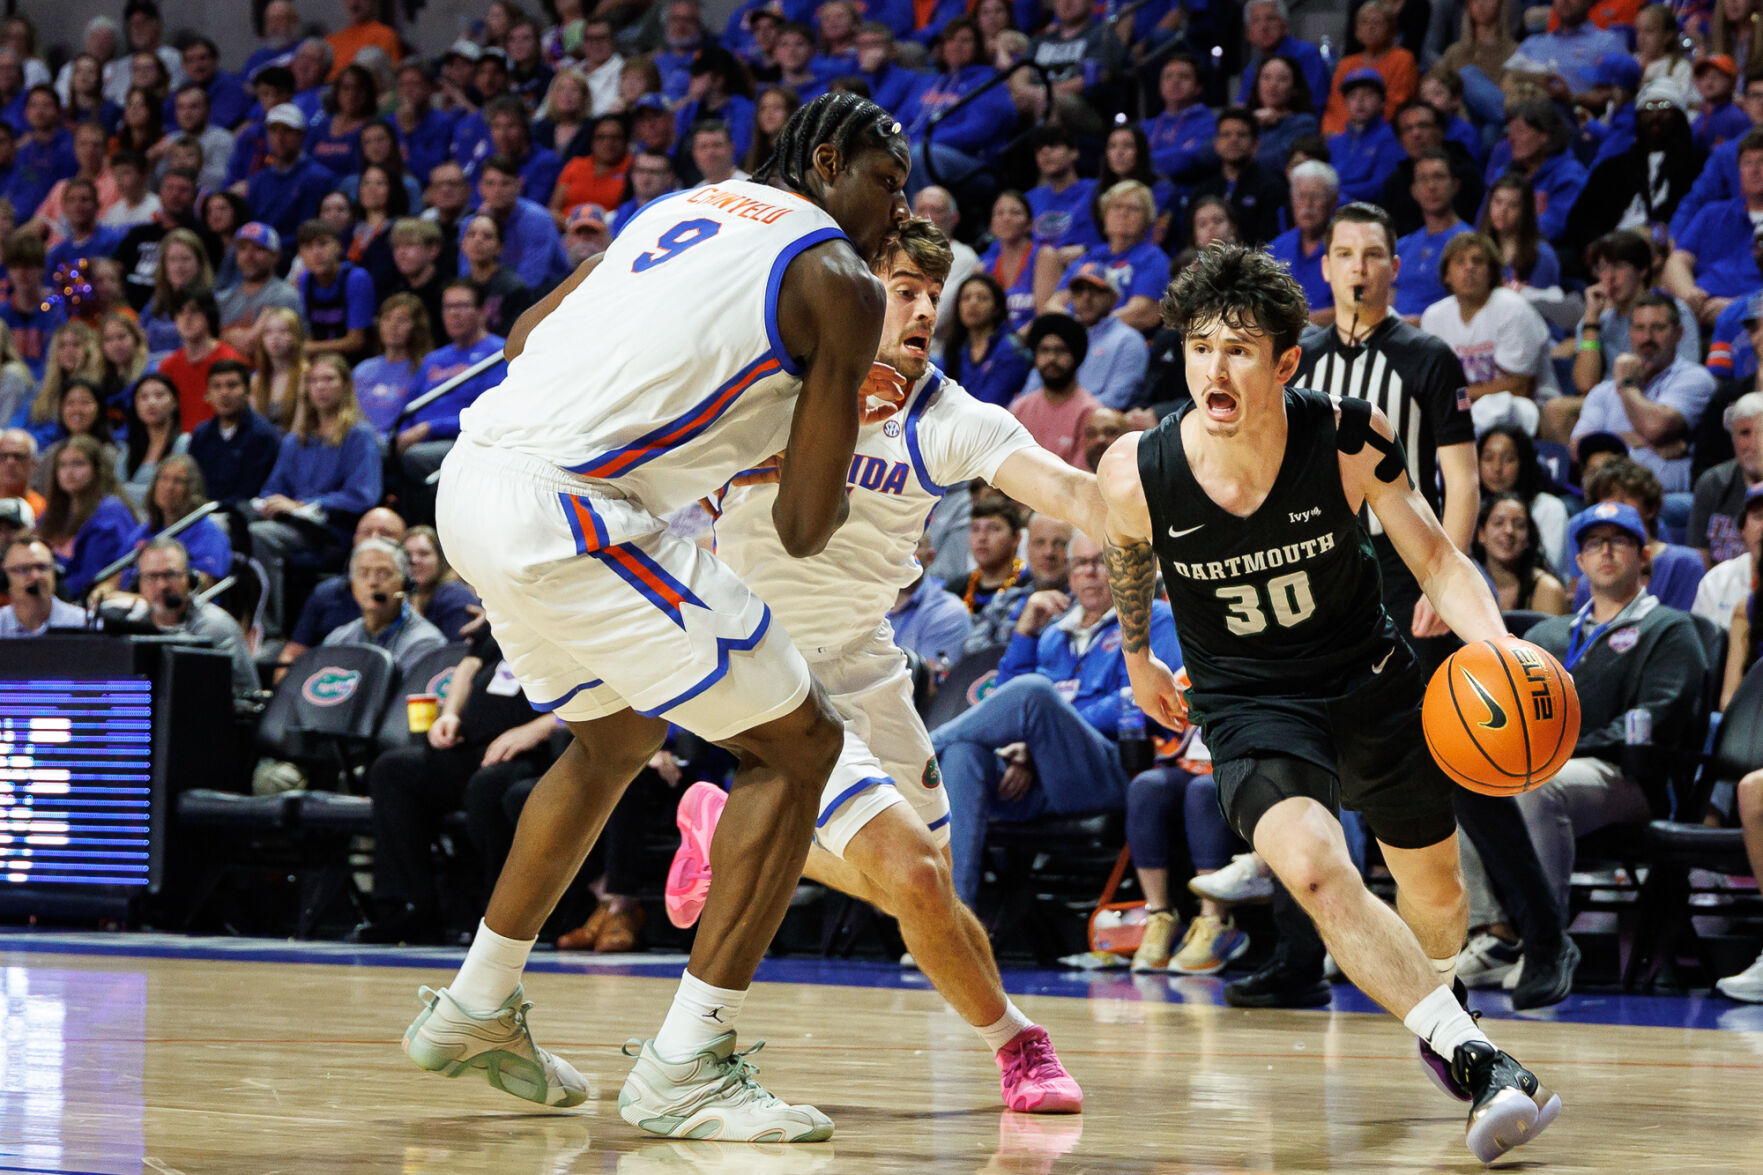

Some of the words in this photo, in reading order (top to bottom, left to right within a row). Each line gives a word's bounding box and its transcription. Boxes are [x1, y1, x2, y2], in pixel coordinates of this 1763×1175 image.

[686, 187, 794, 225] CHINYELU
[631, 218, 722, 273] 9
[847, 453, 910, 495] IDA
[1288, 510, 1310, 523] Ivy
[1173, 532, 1335, 580] DARTMOUTH
[1215, 570, 1316, 637] 30
[1511, 647, 1553, 720] ELITE
